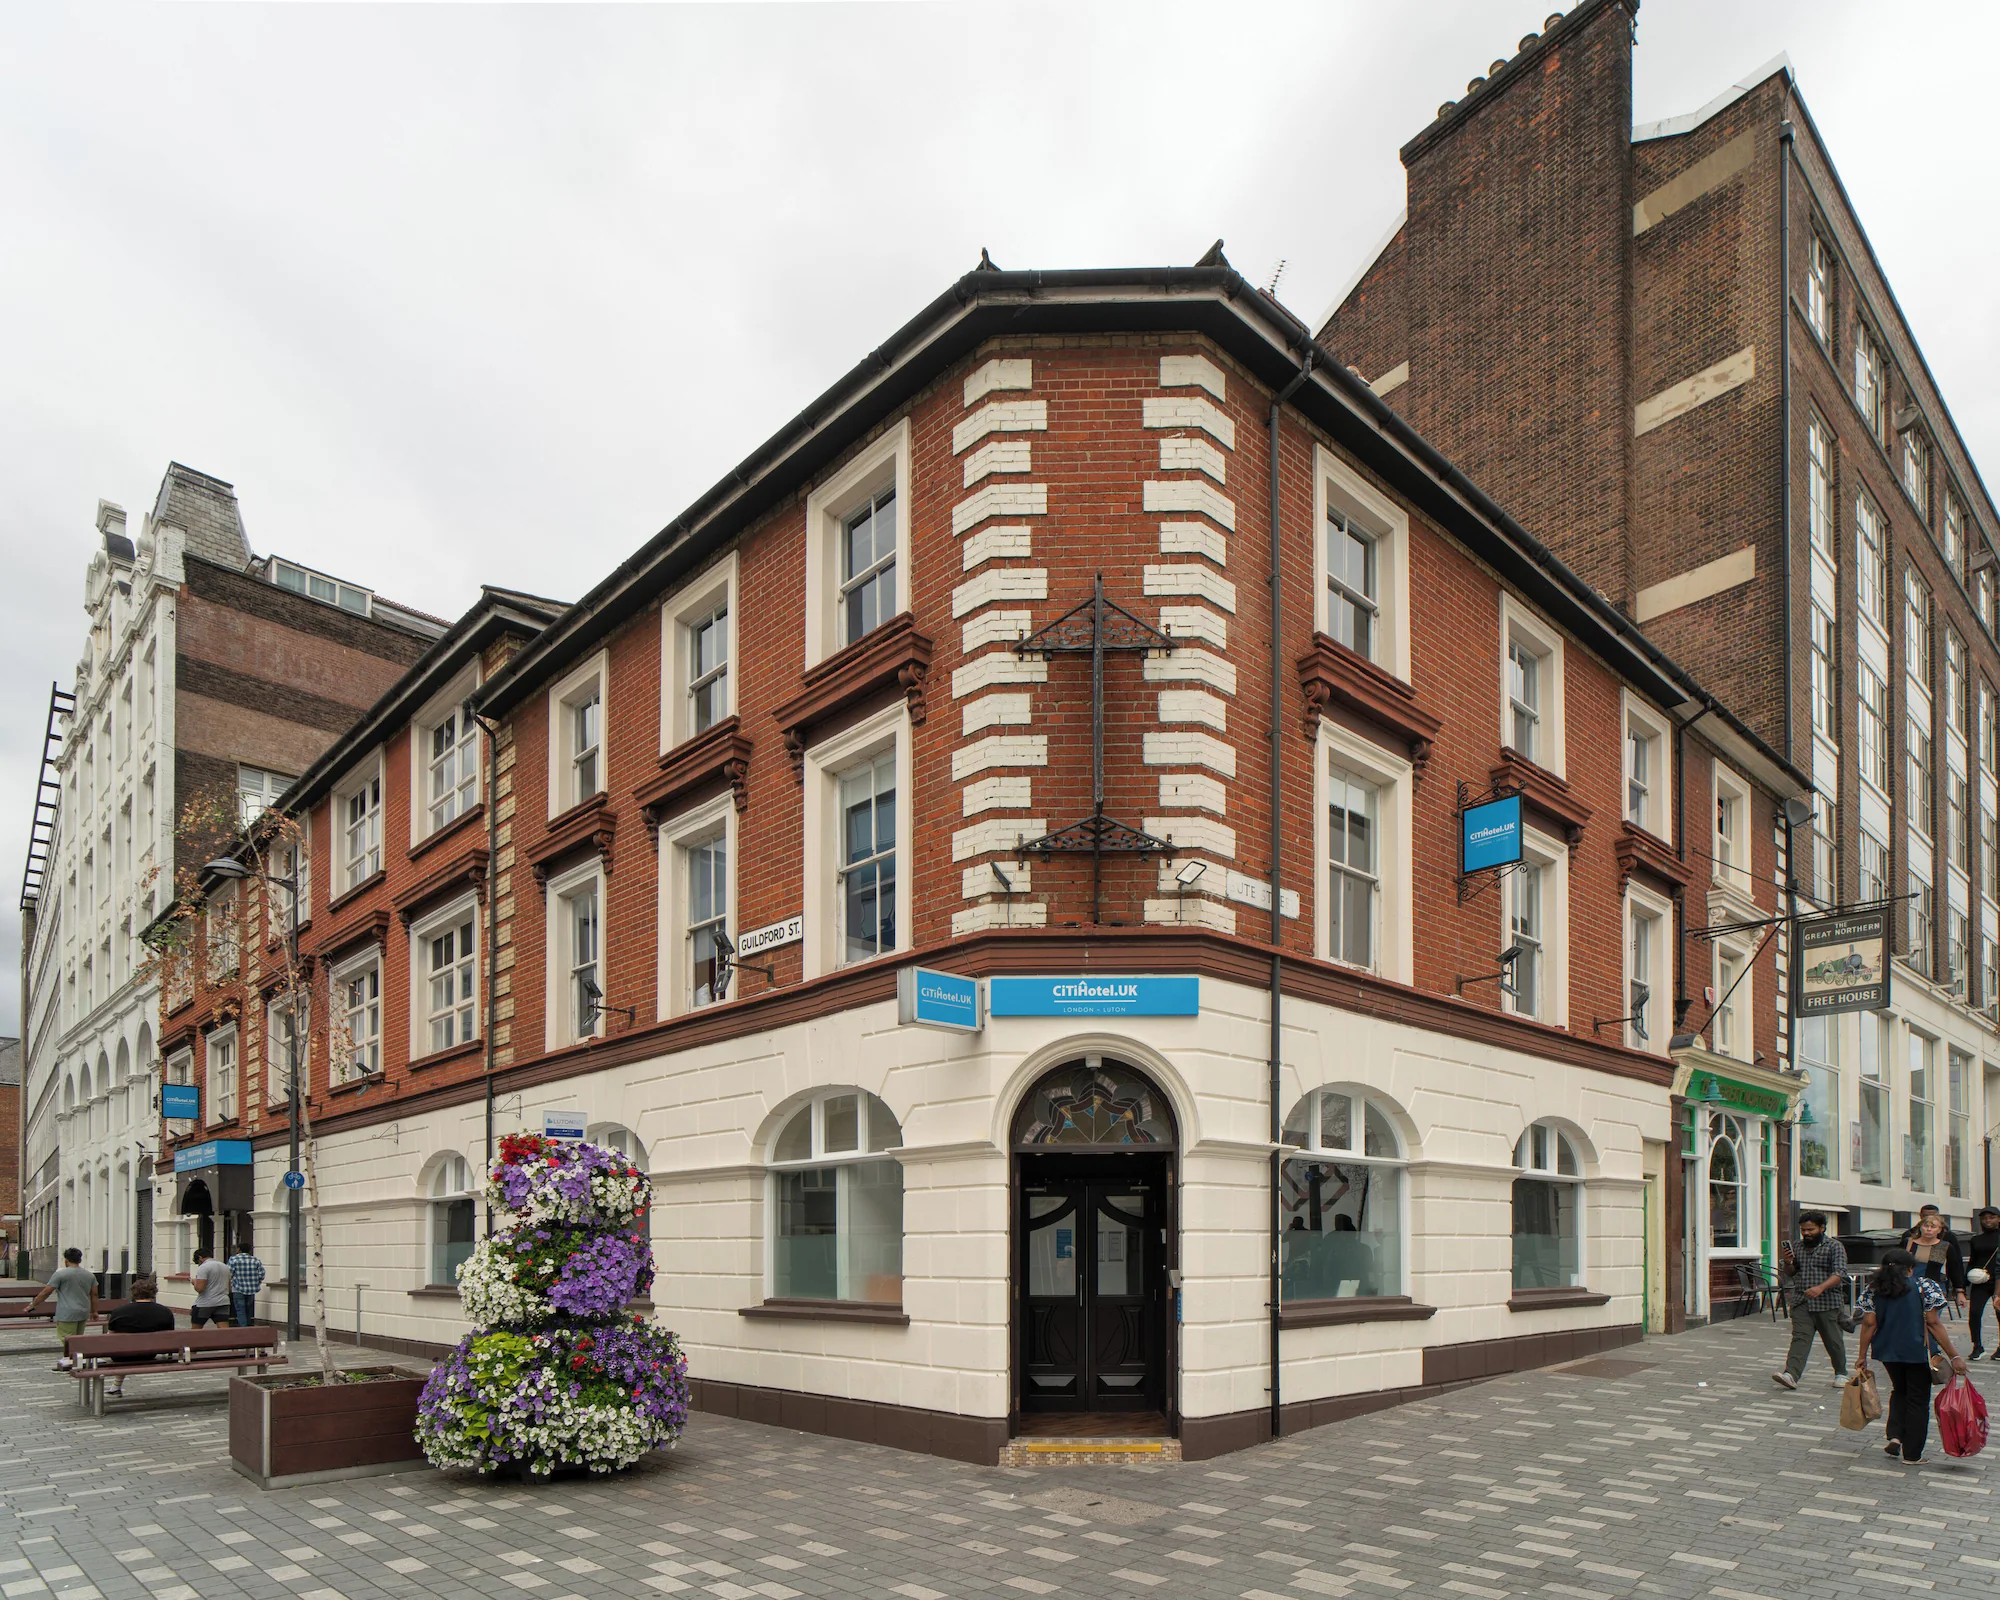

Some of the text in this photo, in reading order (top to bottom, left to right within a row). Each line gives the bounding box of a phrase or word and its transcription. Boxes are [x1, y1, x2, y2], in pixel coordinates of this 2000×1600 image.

[1470, 822, 1516, 841] CiTiHotel.UK
[1230, 882, 1255, 899] UTE
[742, 921, 800, 951] GUILDFORD ST.
[1804, 923, 1880, 941] GREAT NORTHERN
[921, 986, 972, 1005] CiTiHotel.UK
[1052, 980, 1138, 997] CiTiHotel.UK
[1807, 990, 1878, 1007] FREE HOUSE
